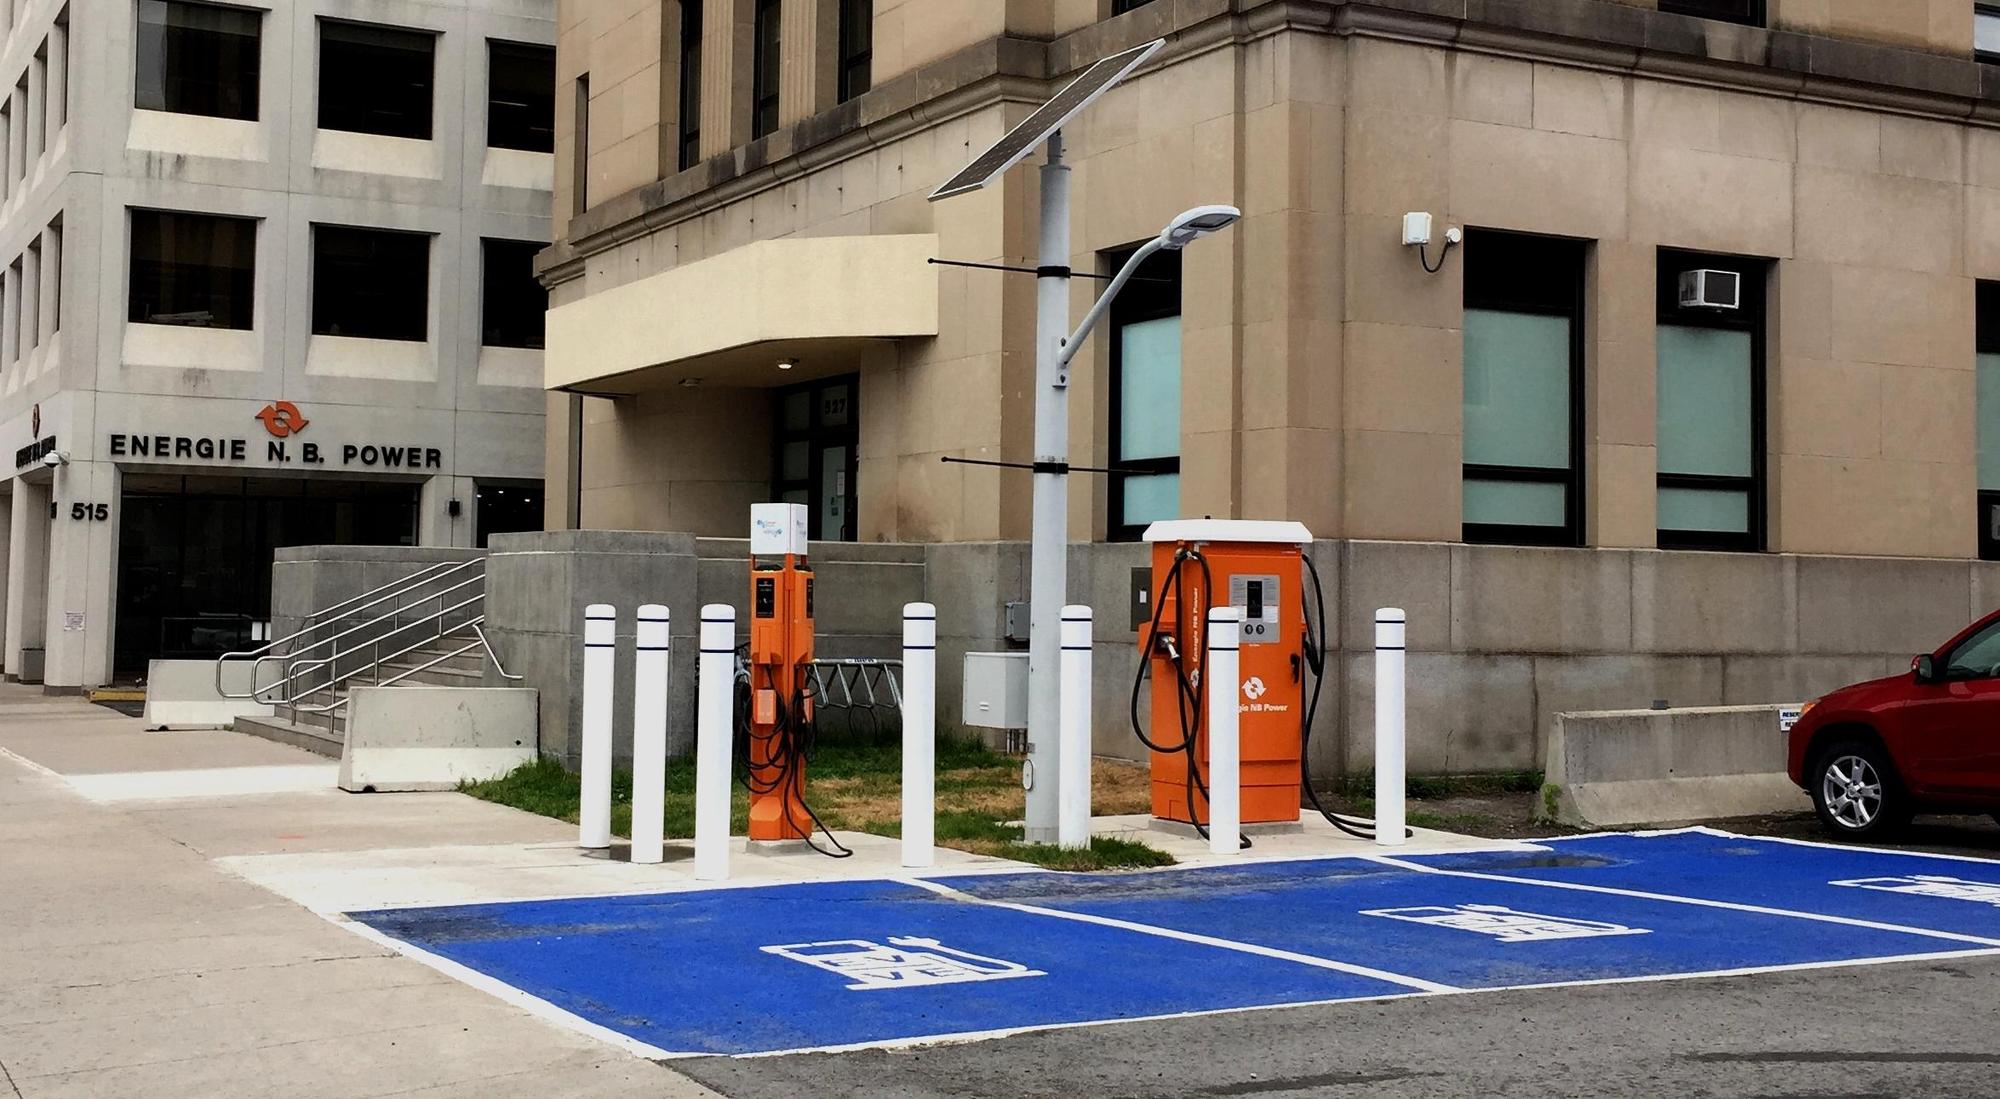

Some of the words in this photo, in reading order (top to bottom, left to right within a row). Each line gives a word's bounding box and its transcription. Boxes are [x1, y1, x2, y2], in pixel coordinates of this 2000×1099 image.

[110, 434, 246, 460] ENERGIE
[343, 445, 441, 468] POWER
[71, 502, 108, 521] 515
[1250, 703, 1263, 712] NB
[1263, 703, 1288, 712] Power
[818, 954, 906, 967] EV
